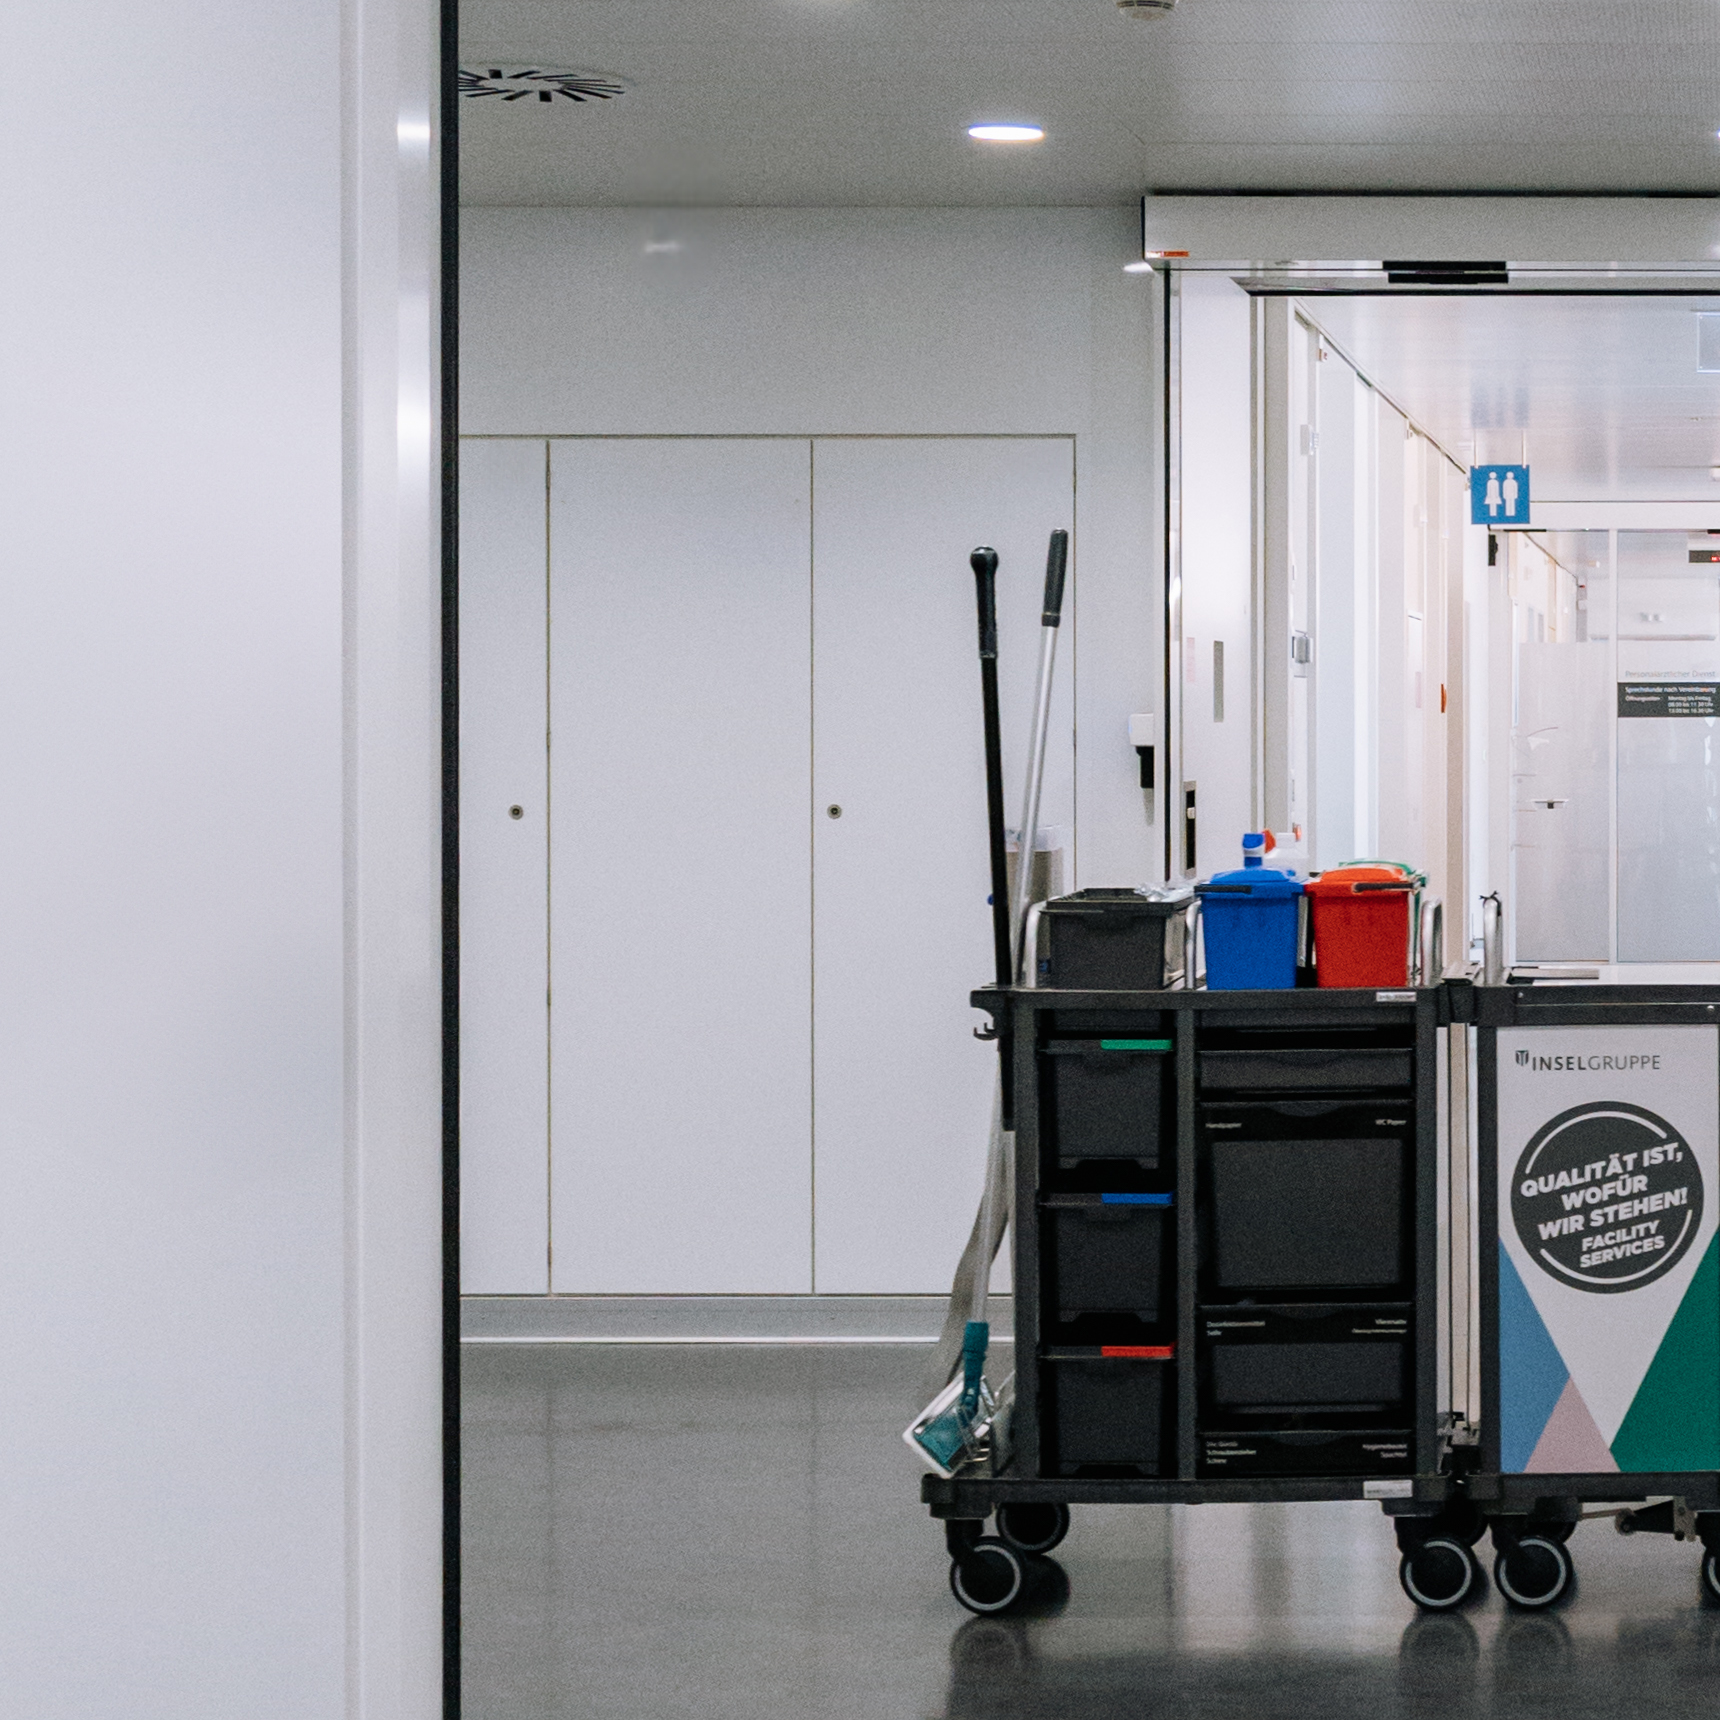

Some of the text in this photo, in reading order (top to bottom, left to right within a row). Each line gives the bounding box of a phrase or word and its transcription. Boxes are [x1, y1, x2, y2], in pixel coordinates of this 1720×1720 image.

[1692, 670, 1716, 678] Dienst
[1532, 1055, 1660, 1071] INSELGRUPPE
[1520, 1142, 1683, 1198] QUALITÄT IST,
[1561, 1174, 1648, 1211] WOFÜR
[1538, 1187, 1688, 1240] WIR STEHEN!
[1580, 1235, 1665, 1268] SERVICES
[1582, 1219, 1660, 1251] FACILITY
